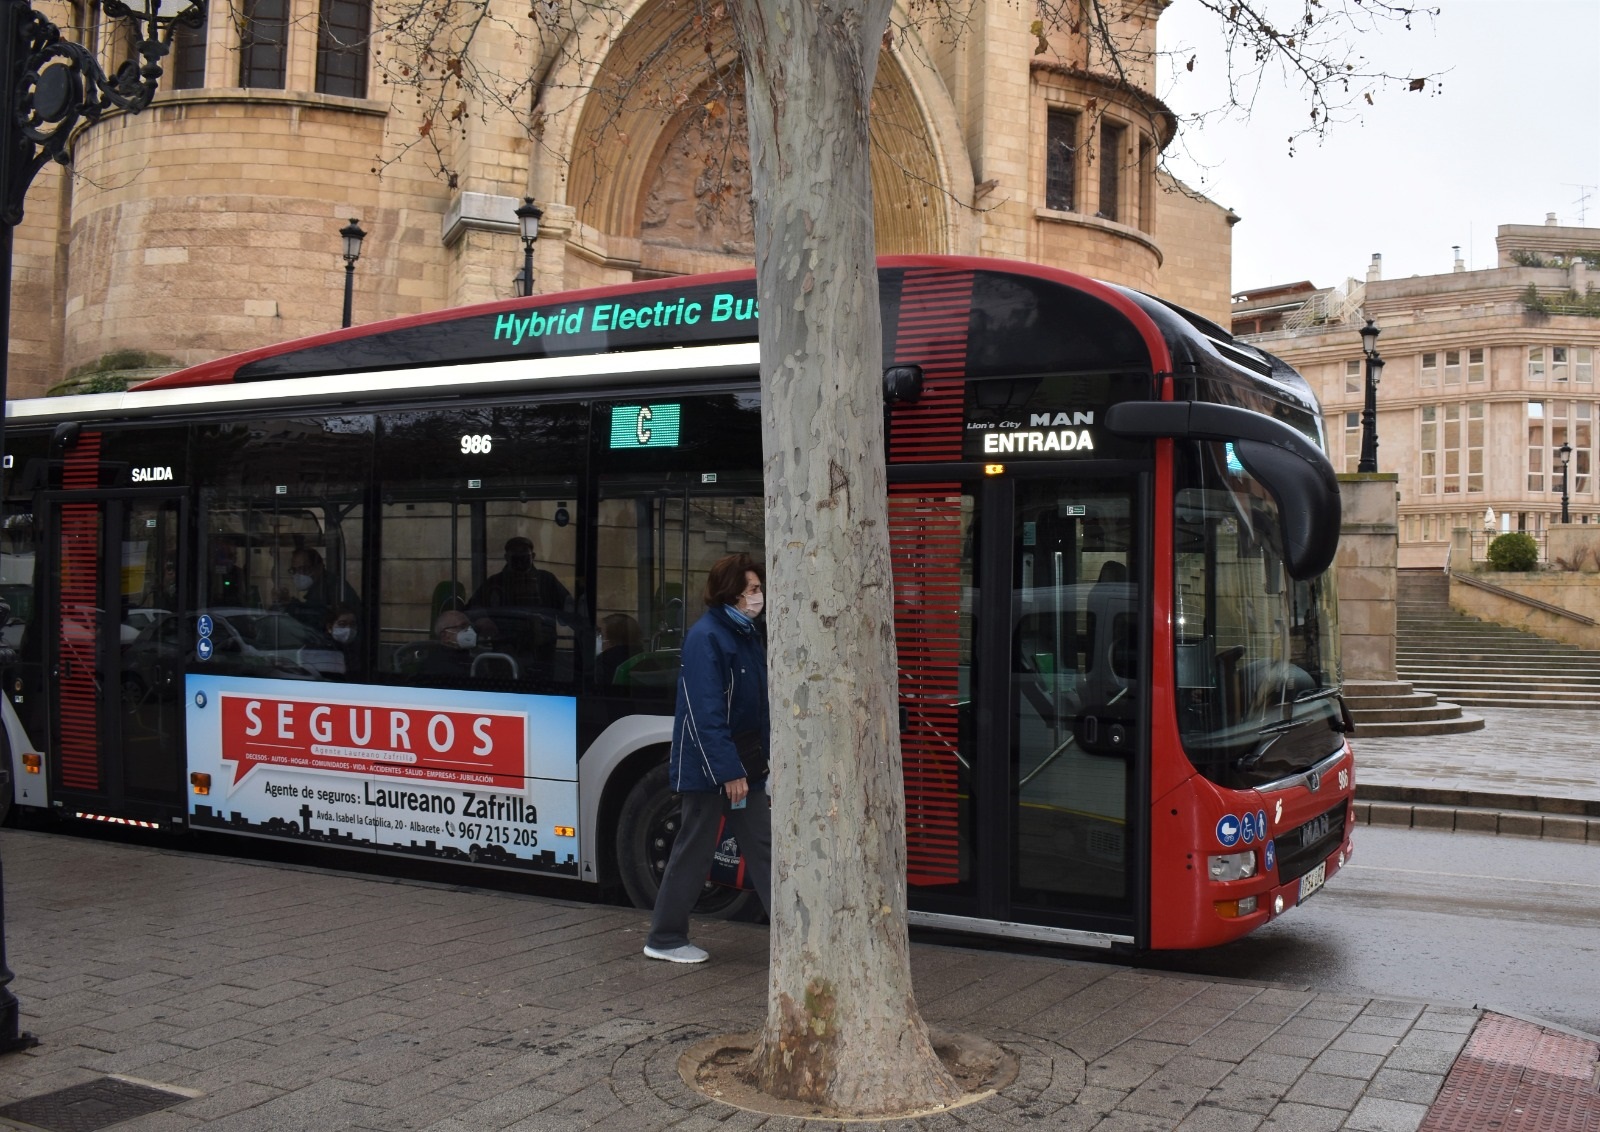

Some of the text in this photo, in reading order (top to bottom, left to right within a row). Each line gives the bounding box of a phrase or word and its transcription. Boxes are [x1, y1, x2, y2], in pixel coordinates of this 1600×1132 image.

[493, 307, 584, 346] Hybrid
[591, 297, 702, 333] Electric
[637, 407, 652, 443] C
[966, 411, 1094, 430] Lion's City MAN
[460, 434, 492, 454] 986
[984, 430, 1094, 453] ENTRADA
[131, 466, 173, 482] SALIDA
[245, 701, 493, 756] SEGUROS
[314, 746, 414, 762] Agente Laureano Zafrilla
[459, 773, 494, 784] JUBILACIÓN
[264, 781, 538, 824] Agente de seguros: Laureano Zafrilla
[316, 810, 335, 822] Avda.
[335, 812, 356, 824] Isabel
[356, 814, 364, 825] la
[394, 819, 404, 830] 20
[409, 821, 441, 835] Albacete
[458, 821, 482, 841] 967
[485, 825, 510, 844] 215
[513, 828, 538, 848] 205
[1302, 813, 1329, 848] MAN
